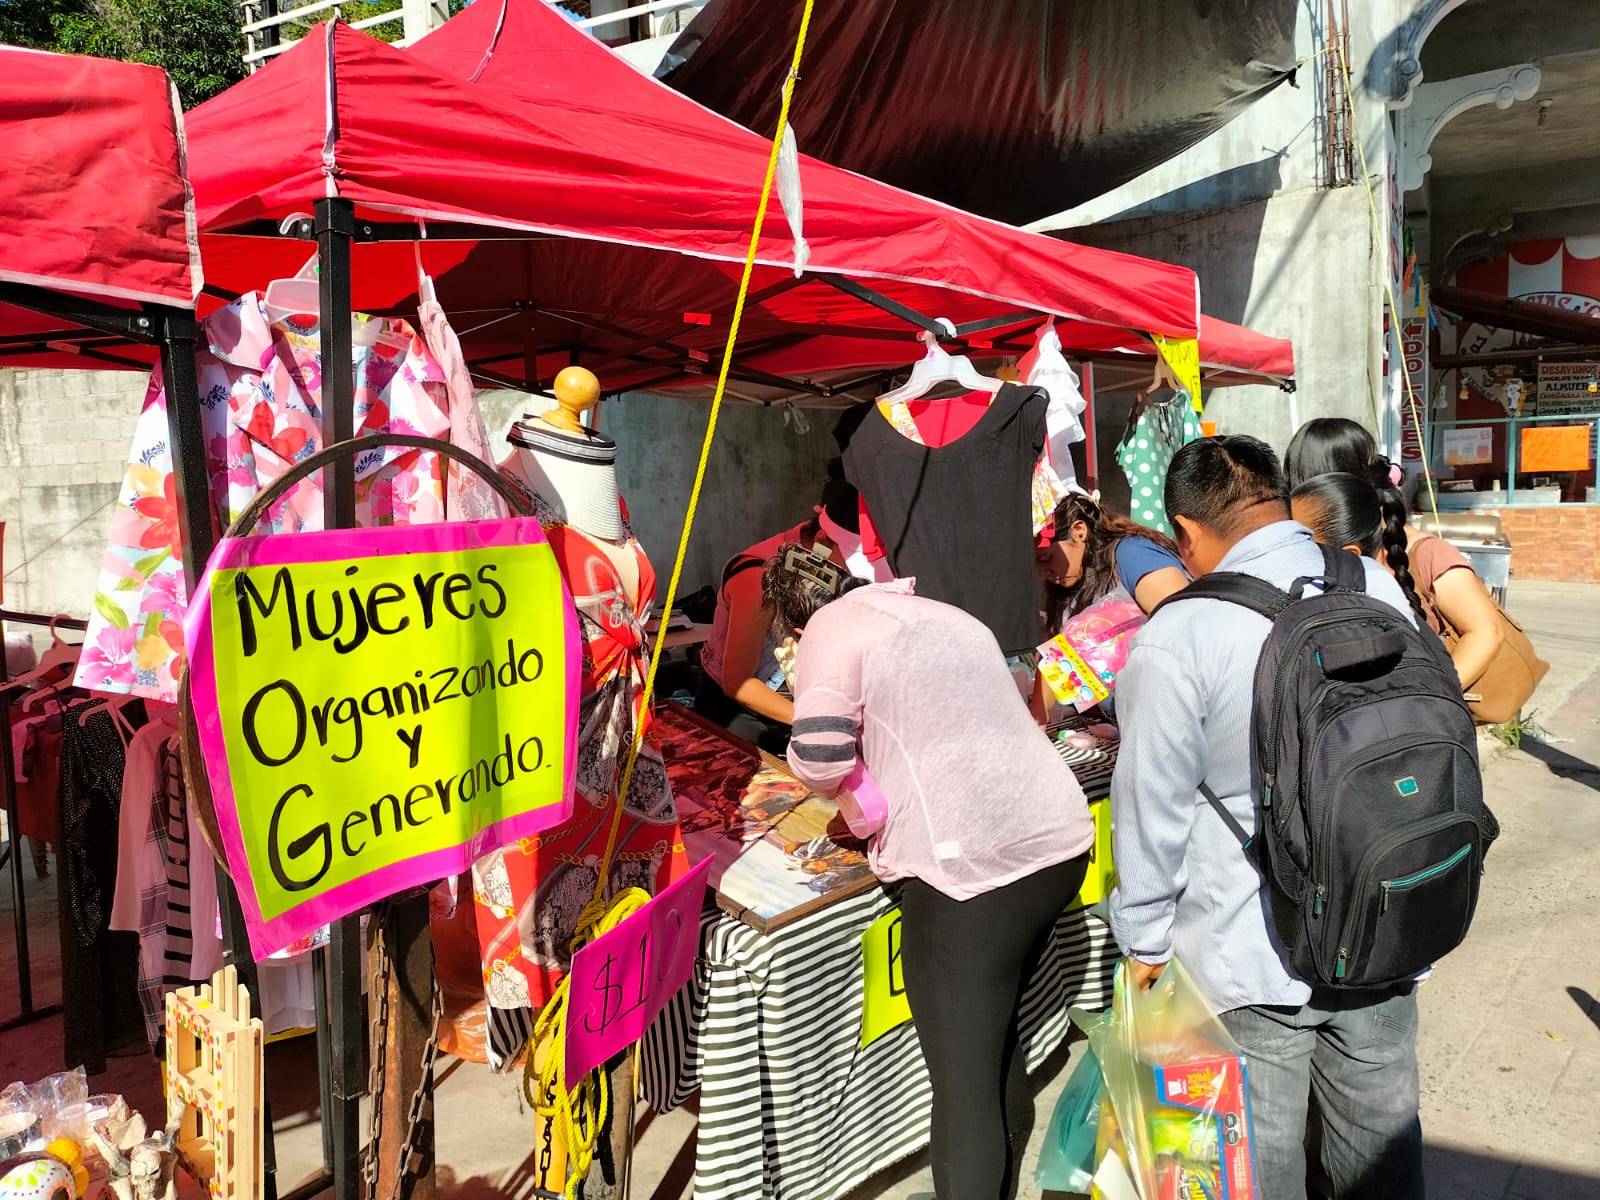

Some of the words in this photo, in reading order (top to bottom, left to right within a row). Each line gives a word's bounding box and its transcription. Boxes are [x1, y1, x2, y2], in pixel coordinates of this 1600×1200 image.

[1402, 340, 1425, 461] DOLARES
[234, 564, 507, 657] Mujeres
[242, 639, 543, 767] Organizando
[267, 733, 552, 892] Generando.
